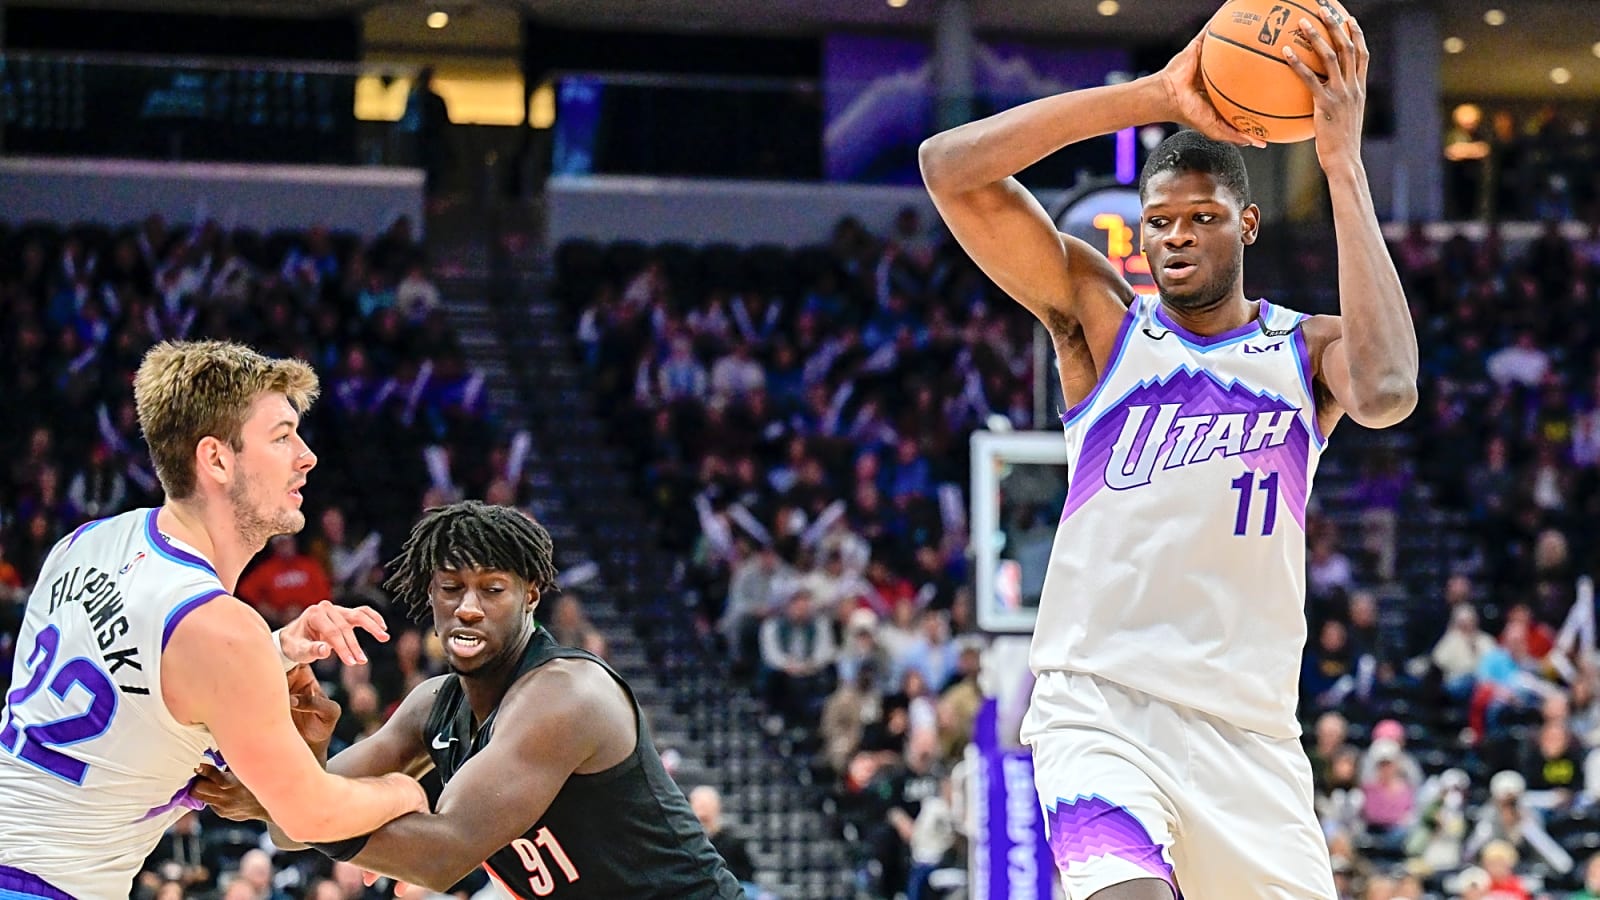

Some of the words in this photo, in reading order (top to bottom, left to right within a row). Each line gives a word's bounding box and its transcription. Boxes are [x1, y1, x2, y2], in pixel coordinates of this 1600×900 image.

[1244, 341, 1284, 354] LVT
[1104, 402, 1303, 491] UTAH
[1231, 471, 1279, 537] 11
[0, 623, 118, 786] 22
[510, 826, 580, 896] 91
